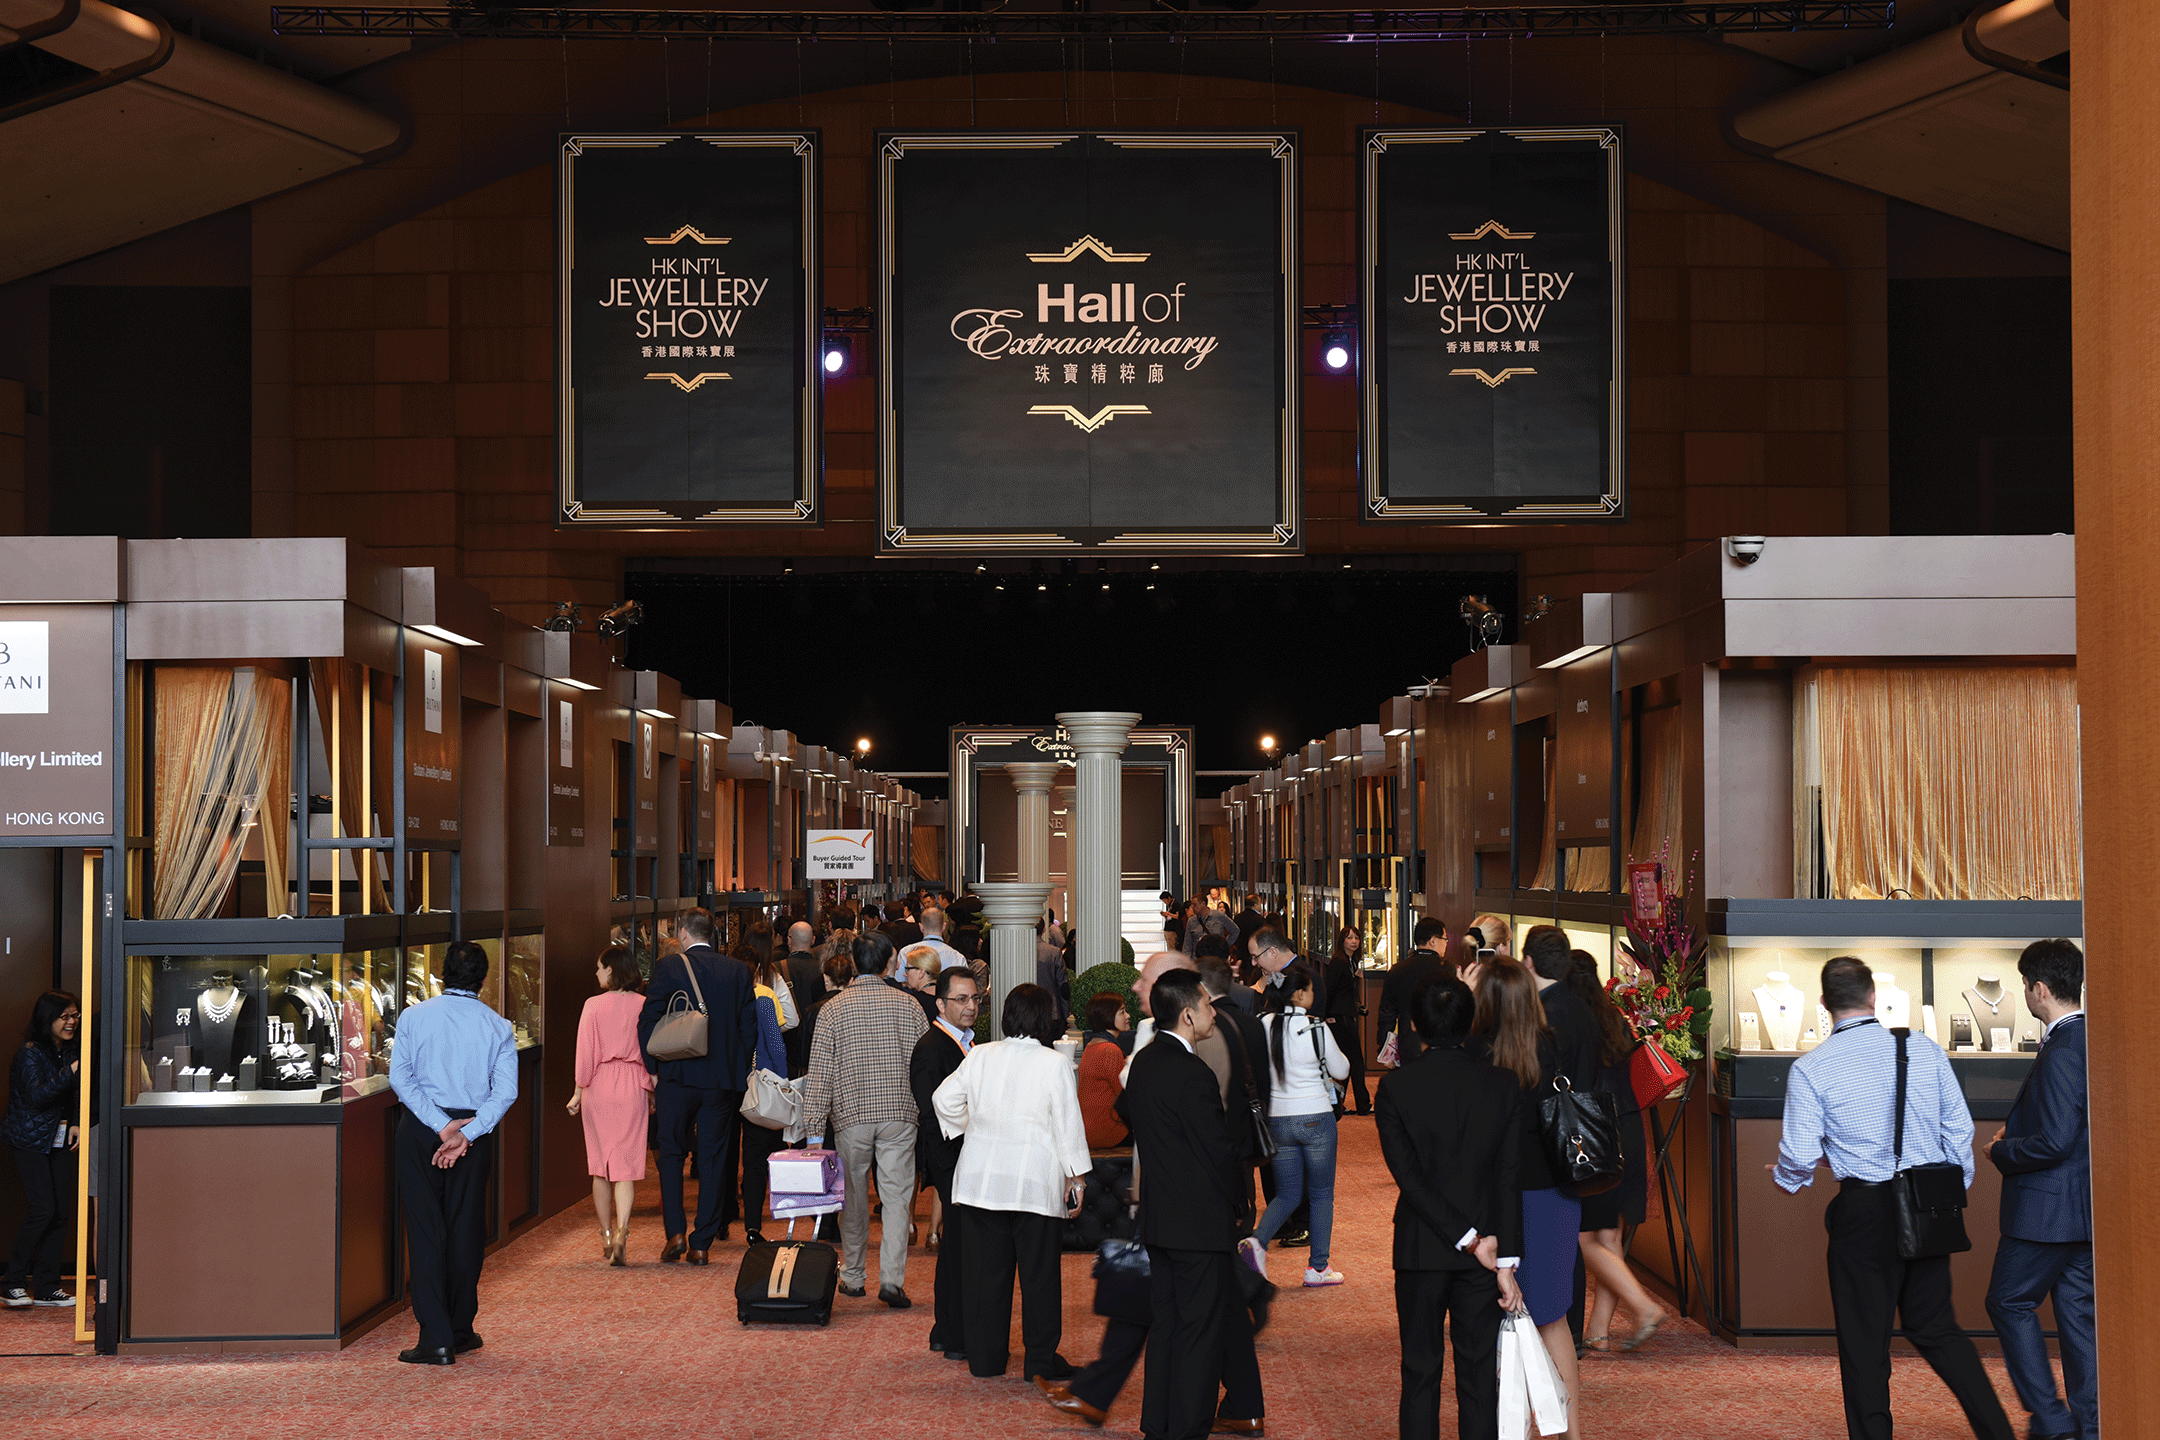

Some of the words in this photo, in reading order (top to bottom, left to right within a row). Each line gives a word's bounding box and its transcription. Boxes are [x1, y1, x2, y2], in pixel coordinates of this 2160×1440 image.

[652, 258, 678, 275] HK
[1456, 253, 1482, 270] HK
[599, 278, 769, 307] JEWELLERY
[1403, 272, 1574, 303] JEWELLERY
[1037, 283, 1135, 323] Hall
[1142, 282, 1187, 323] of
[635, 308, 742, 338] SHOW
[1439, 303, 1547, 334] SHOW
[950, 308, 1219, 371] Extraordinary
[1445, 340, 1540, 353] 香港國際珠寶展
[641, 345, 736, 358] 香港國際珠寶展
[1034, 363, 1165, 384] 珠寶精粹廊
[40, 751, 102, 767] Limited
[6, 812, 53, 826] HONG
[58, 811, 105, 825] KONG
